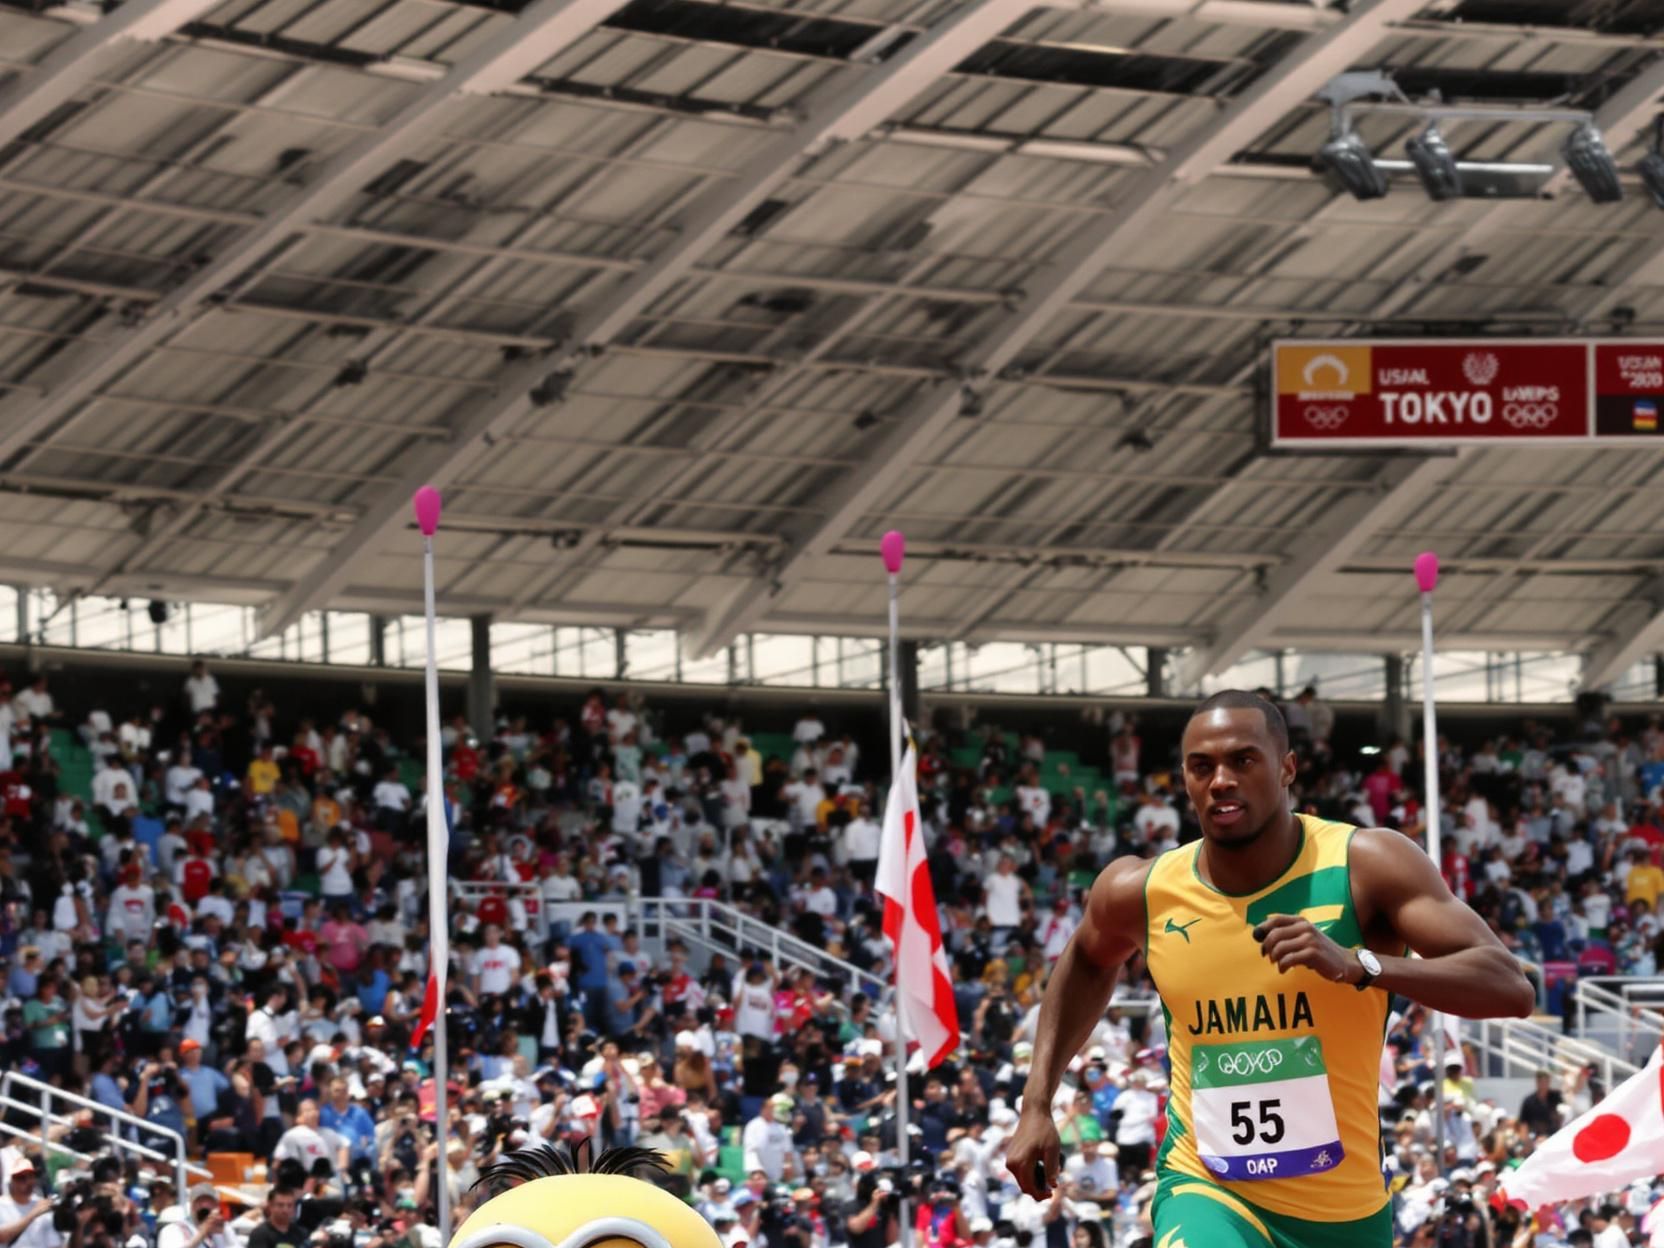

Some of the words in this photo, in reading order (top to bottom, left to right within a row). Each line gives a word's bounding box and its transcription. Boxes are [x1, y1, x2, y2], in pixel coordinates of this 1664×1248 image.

[1378, 391, 1493, 424] TOKYO
[1188, 991, 1315, 1036] JAMAIA
[1231, 1098, 1286, 1146] 55
[1246, 1158, 1278, 1175] OAP
